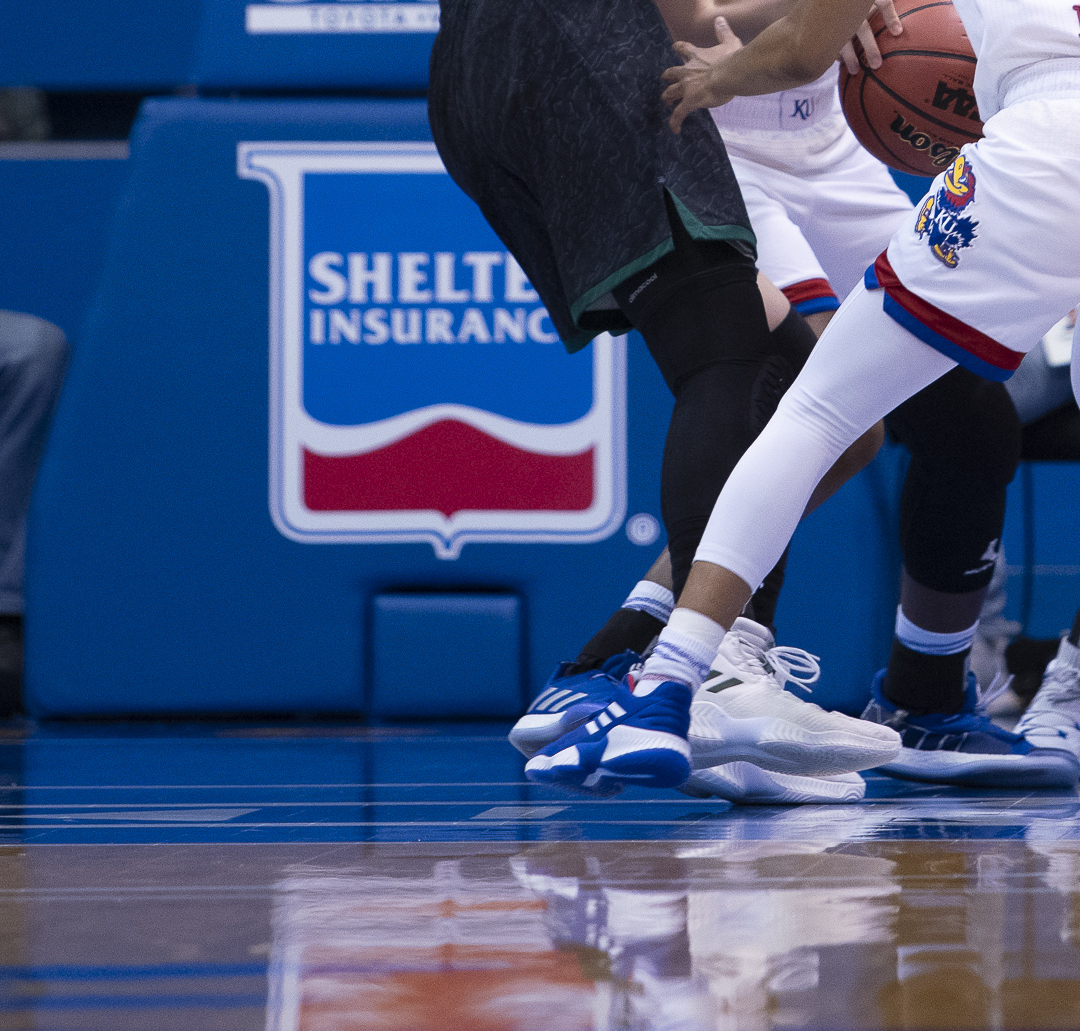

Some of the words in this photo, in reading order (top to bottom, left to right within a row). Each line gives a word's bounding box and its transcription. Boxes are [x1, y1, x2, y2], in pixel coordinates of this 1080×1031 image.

[890, 114, 961, 167] lson
[935, 208, 958, 235] KU
[308, 251, 541, 305] SHELTE
[308, 307, 560, 345] INSURANC
